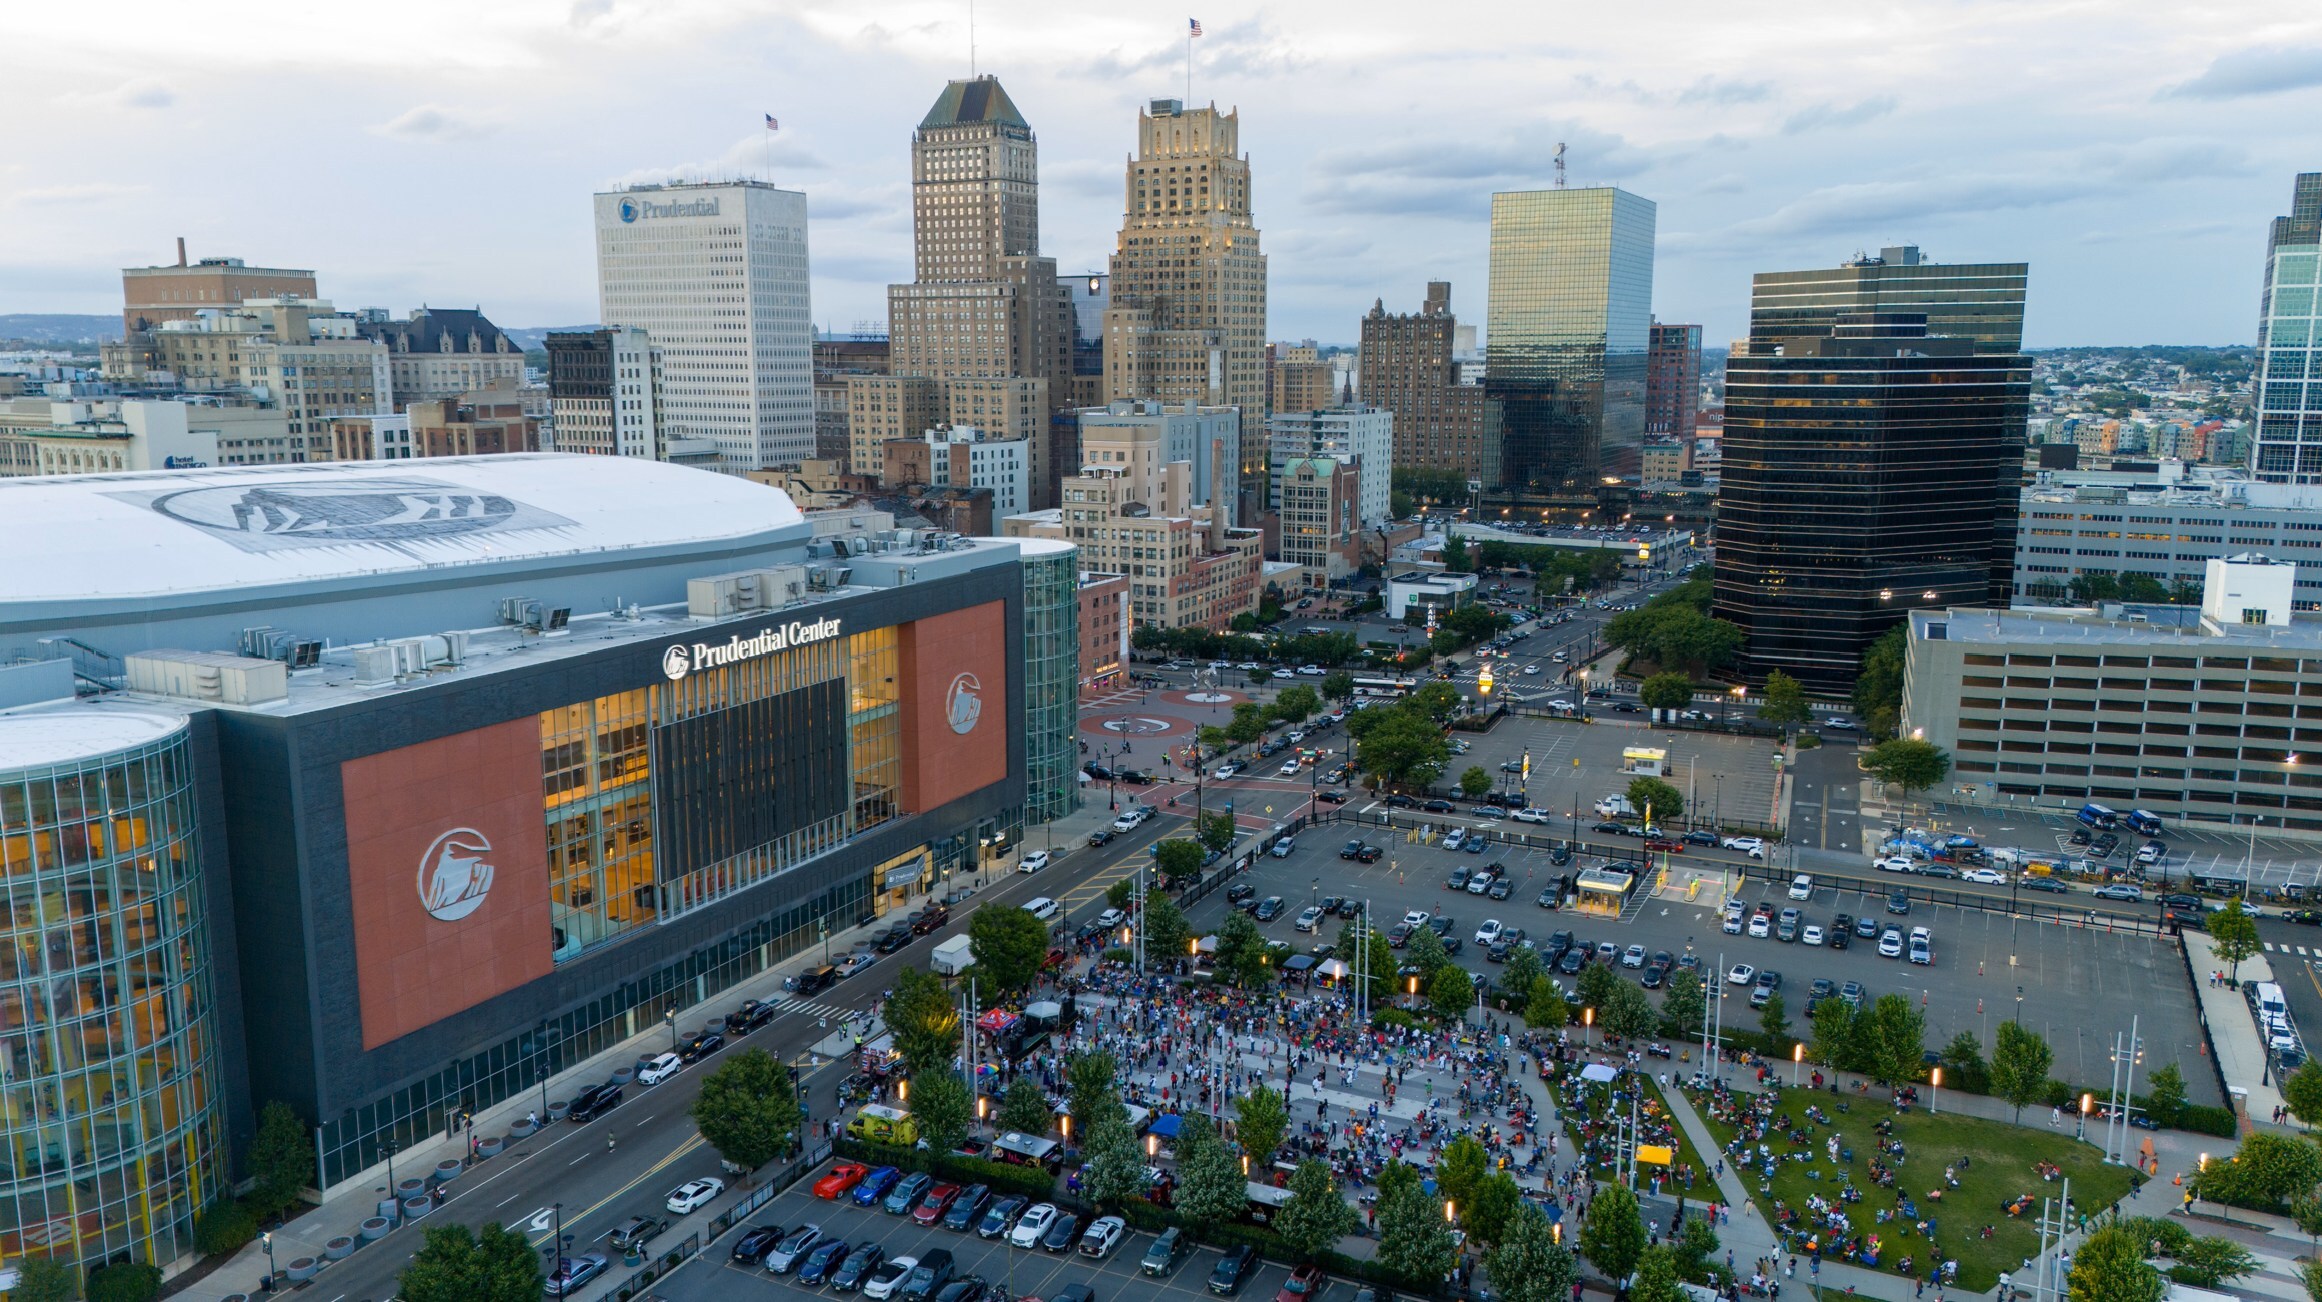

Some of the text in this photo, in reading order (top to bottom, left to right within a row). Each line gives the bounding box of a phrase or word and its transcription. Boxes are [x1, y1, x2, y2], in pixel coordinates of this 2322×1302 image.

[642, 197, 720, 218] Prudential
[175, 455, 194, 463] hotel
[691, 616, 841, 671] Prudential Center
